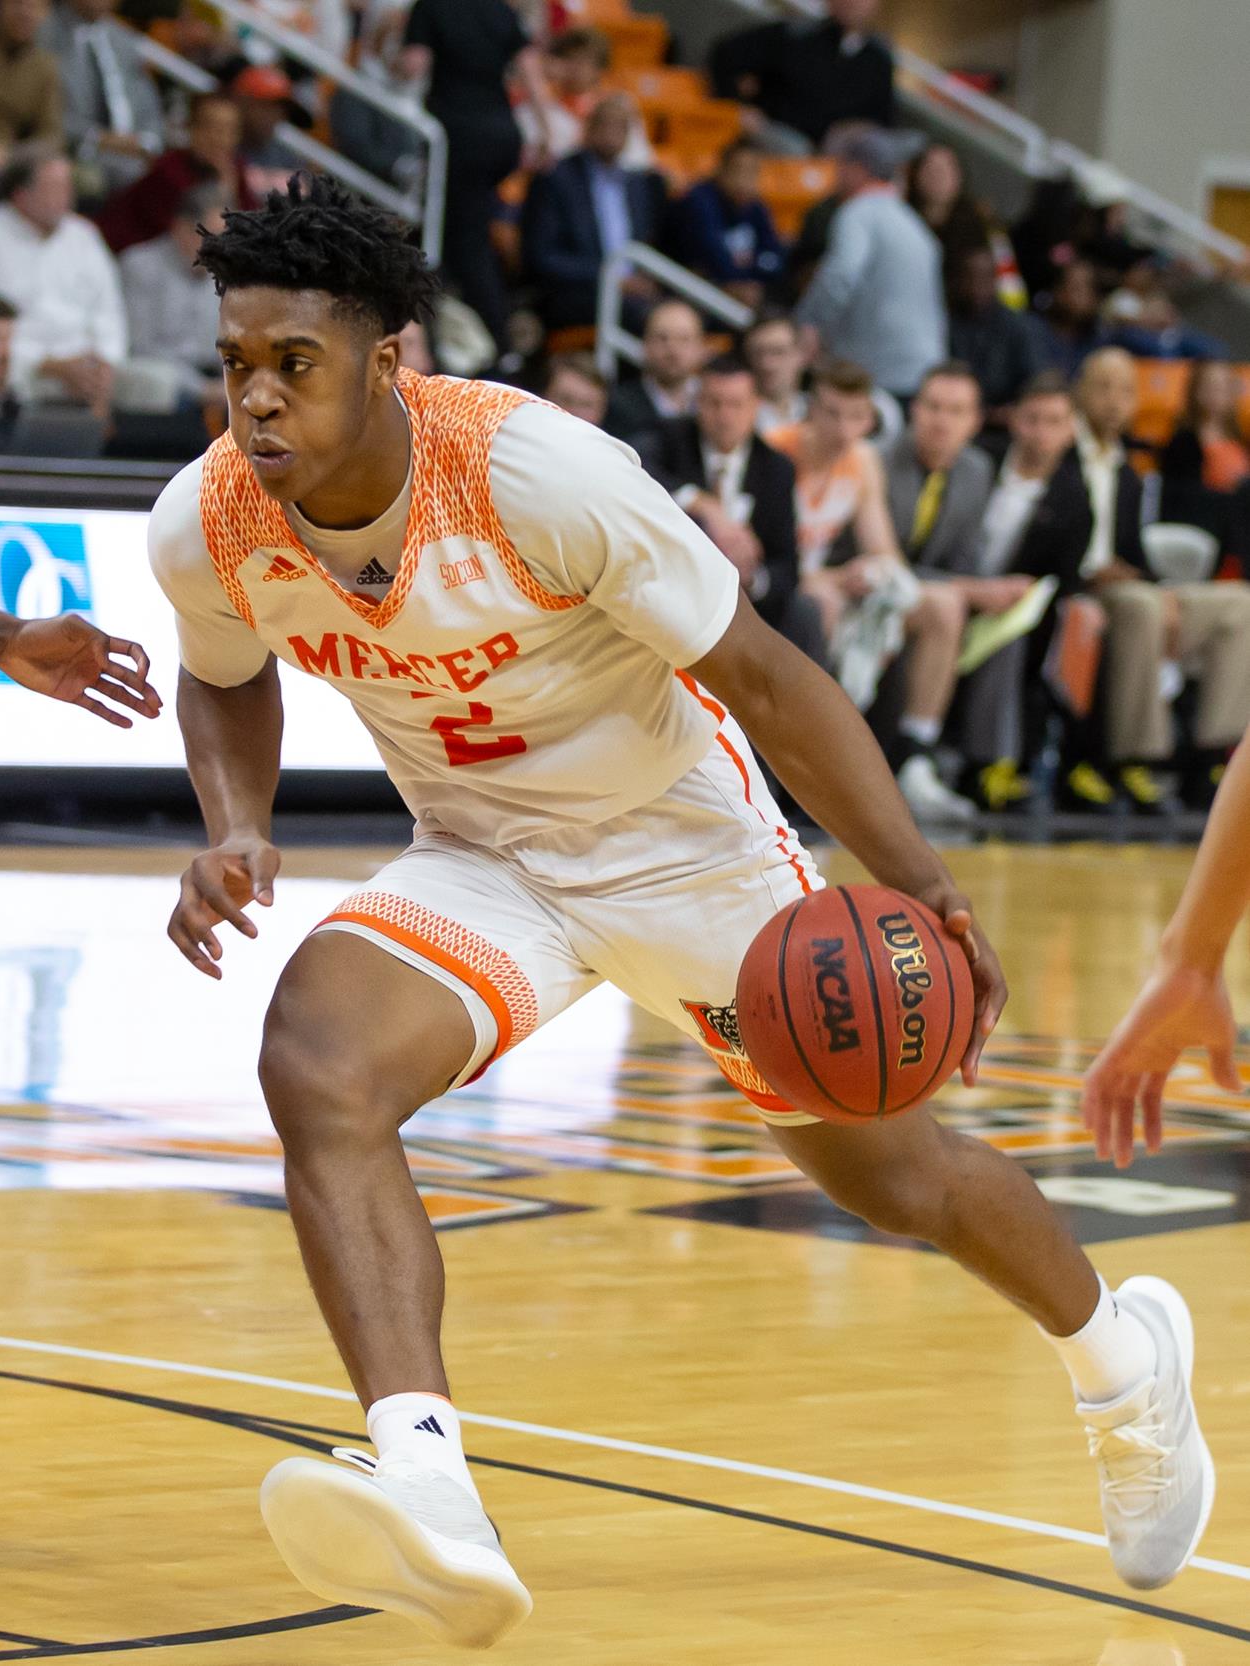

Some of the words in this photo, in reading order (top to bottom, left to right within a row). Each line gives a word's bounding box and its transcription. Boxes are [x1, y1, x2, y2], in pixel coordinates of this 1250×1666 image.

[439, 553, 486, 590] SOCON
[812, 937, 862, 1053] NCAA
[876, 911, 932, 1070] Wilson
